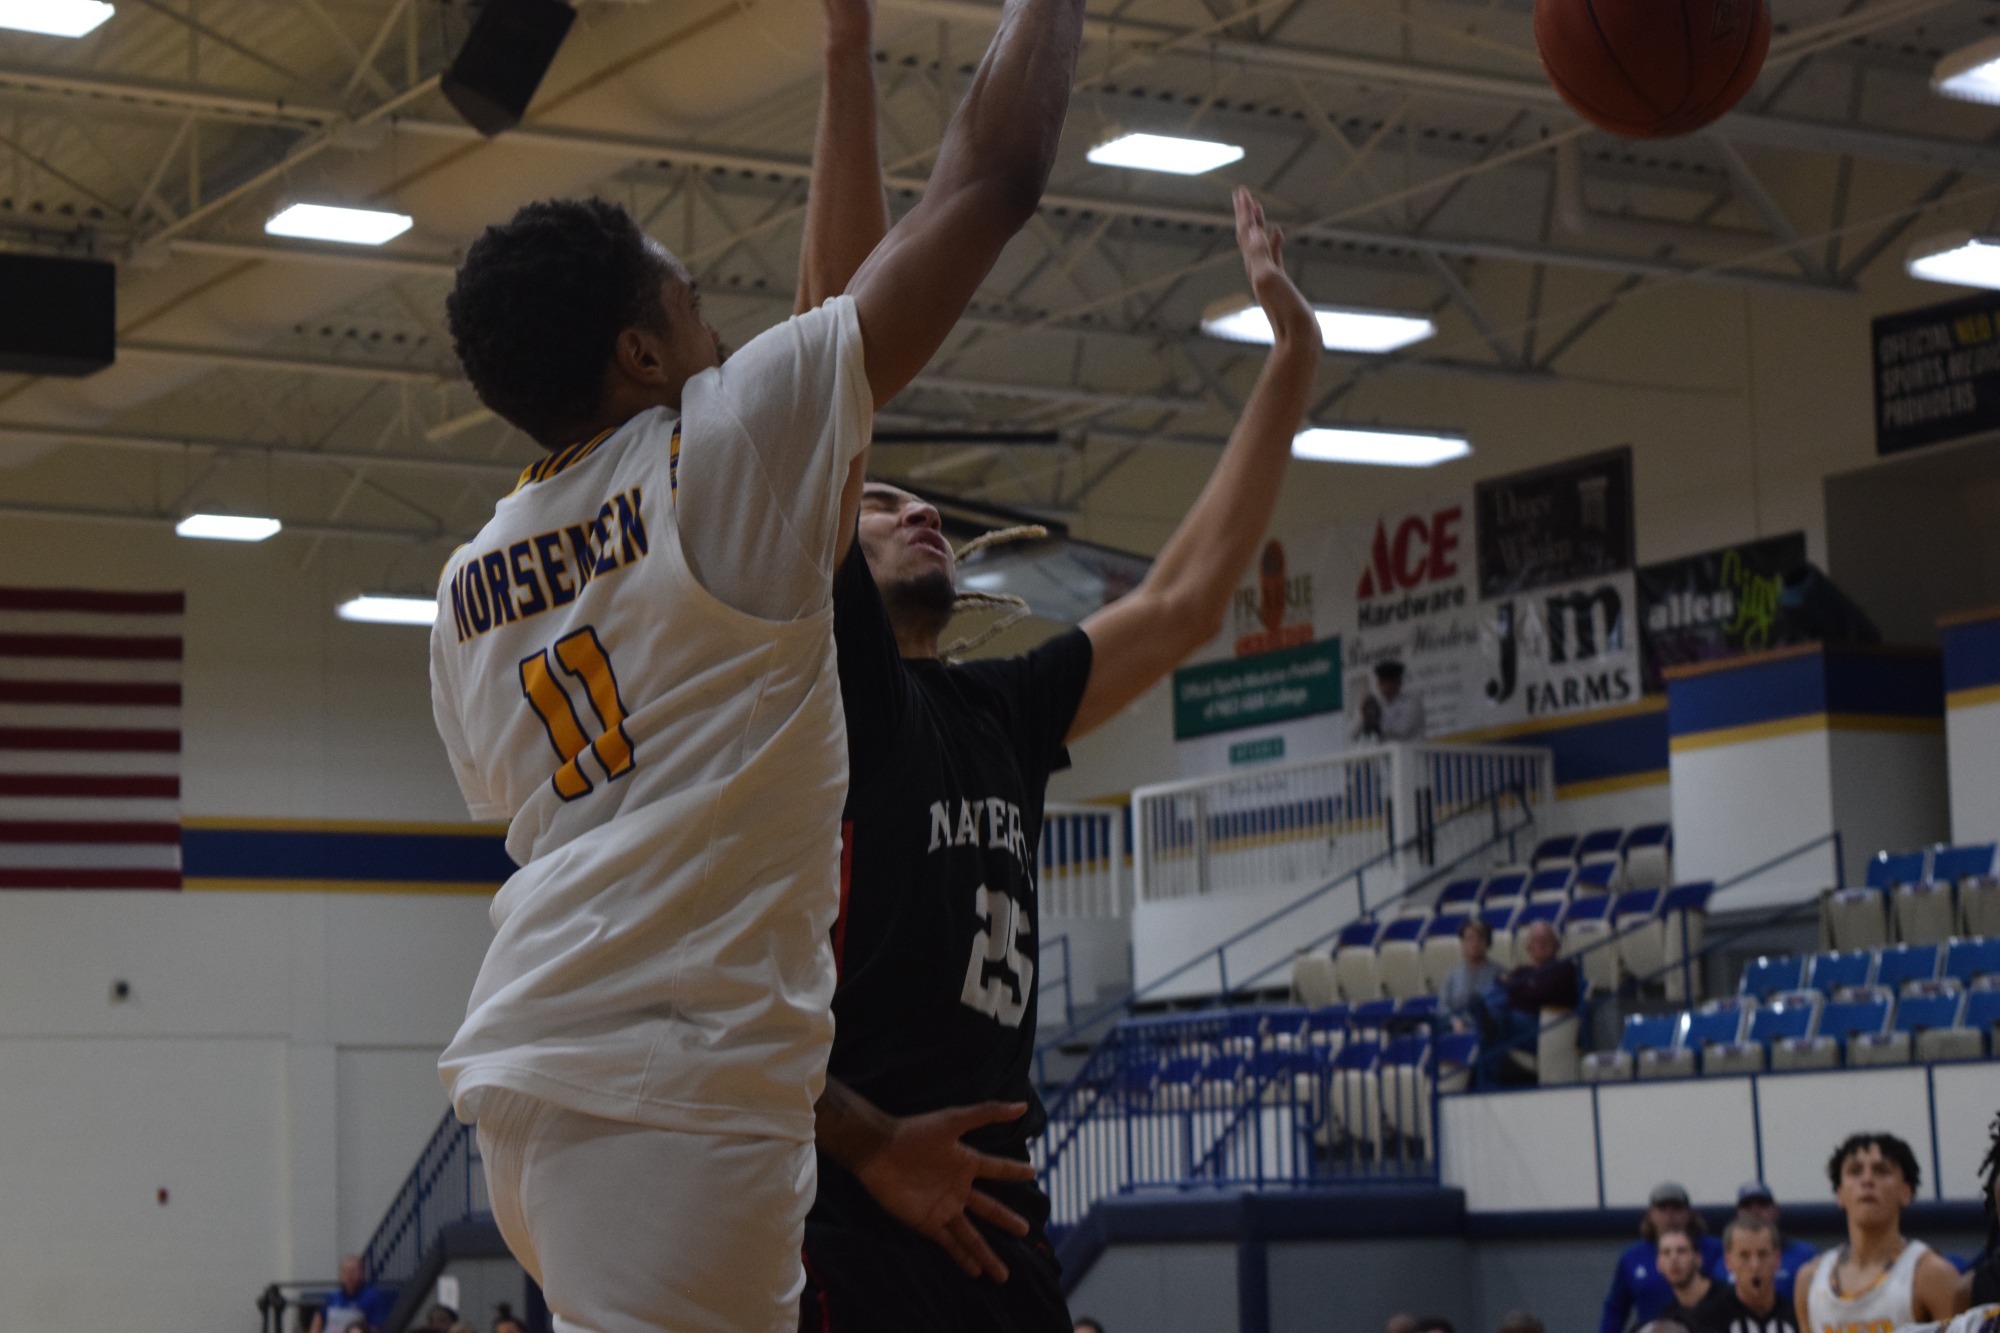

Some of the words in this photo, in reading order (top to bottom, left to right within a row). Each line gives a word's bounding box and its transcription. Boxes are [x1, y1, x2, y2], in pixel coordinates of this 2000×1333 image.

[451, 486, 648, 643] NORSEMEN
[1357, 505, 1463, 599] ACE
[1358, 586, 1467, 631] Hardware
[519, 625, 636, 802] 11
[1526, 668, 1631, 716] FARMS
[959, 882, 1034, 1029] 25
